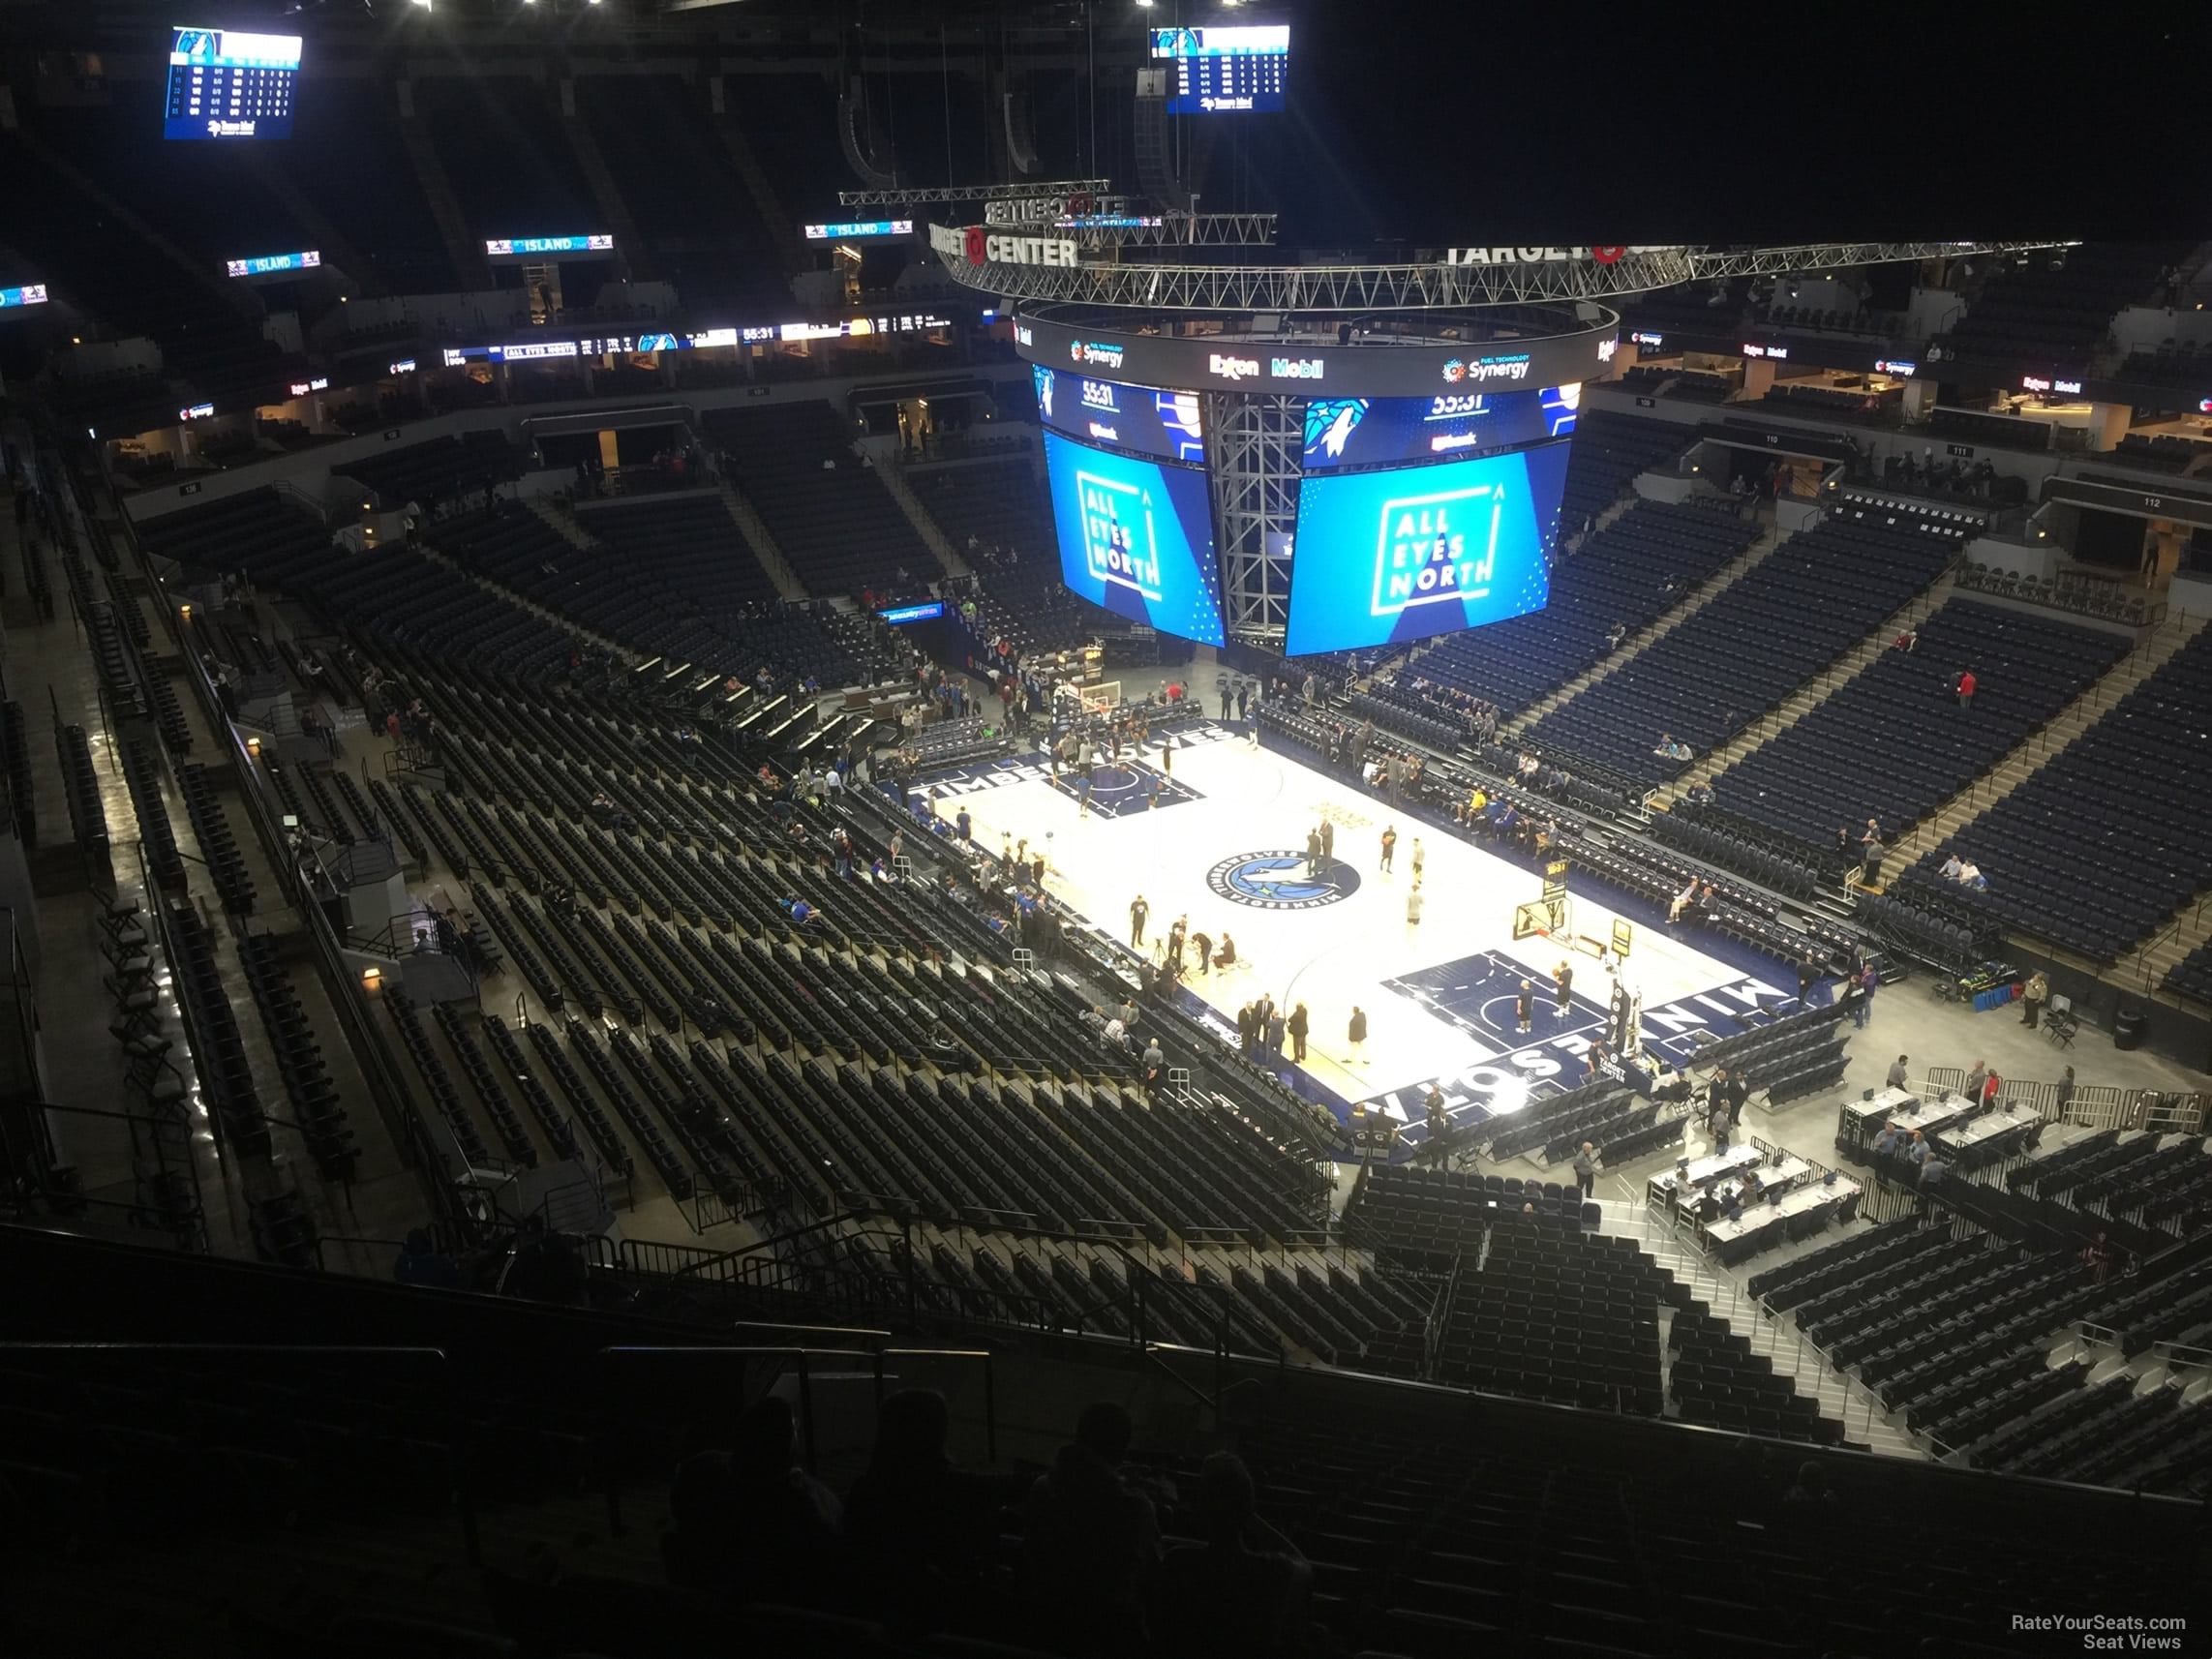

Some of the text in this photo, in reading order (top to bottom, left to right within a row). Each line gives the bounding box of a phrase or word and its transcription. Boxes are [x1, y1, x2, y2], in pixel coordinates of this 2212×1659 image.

[837, 223, 879, 235] ISLAND
[525, 238, 573, 252] ISLAND
[985, 234, 1078, 267] CENTER
[256, 256, 291, 272] ISLAND
[742, 326, 774, 341] 55:31
[1083, 344, 1123, 369] Synergy
[1271, 357, 1324, 379] Mobil
[1469, 360, 1530, 382] Synergy
[1082, 380, 1114, 407] 55:31
[1767, 435, 1778, 444] 110
[1953, 446, 1967, 457] 111
[1086, 487, 1118, 520] ALL
[2144, 498, 2161, 508] 112
[1089, 515, 1133, 551] EYES
[1395, 507, 1449, 539] ALL
[1393, 534, 1465, 569] EYES
[1092, 543, 1161, 588] NORTH
[1389, 558, 1493, 598] NORTH
